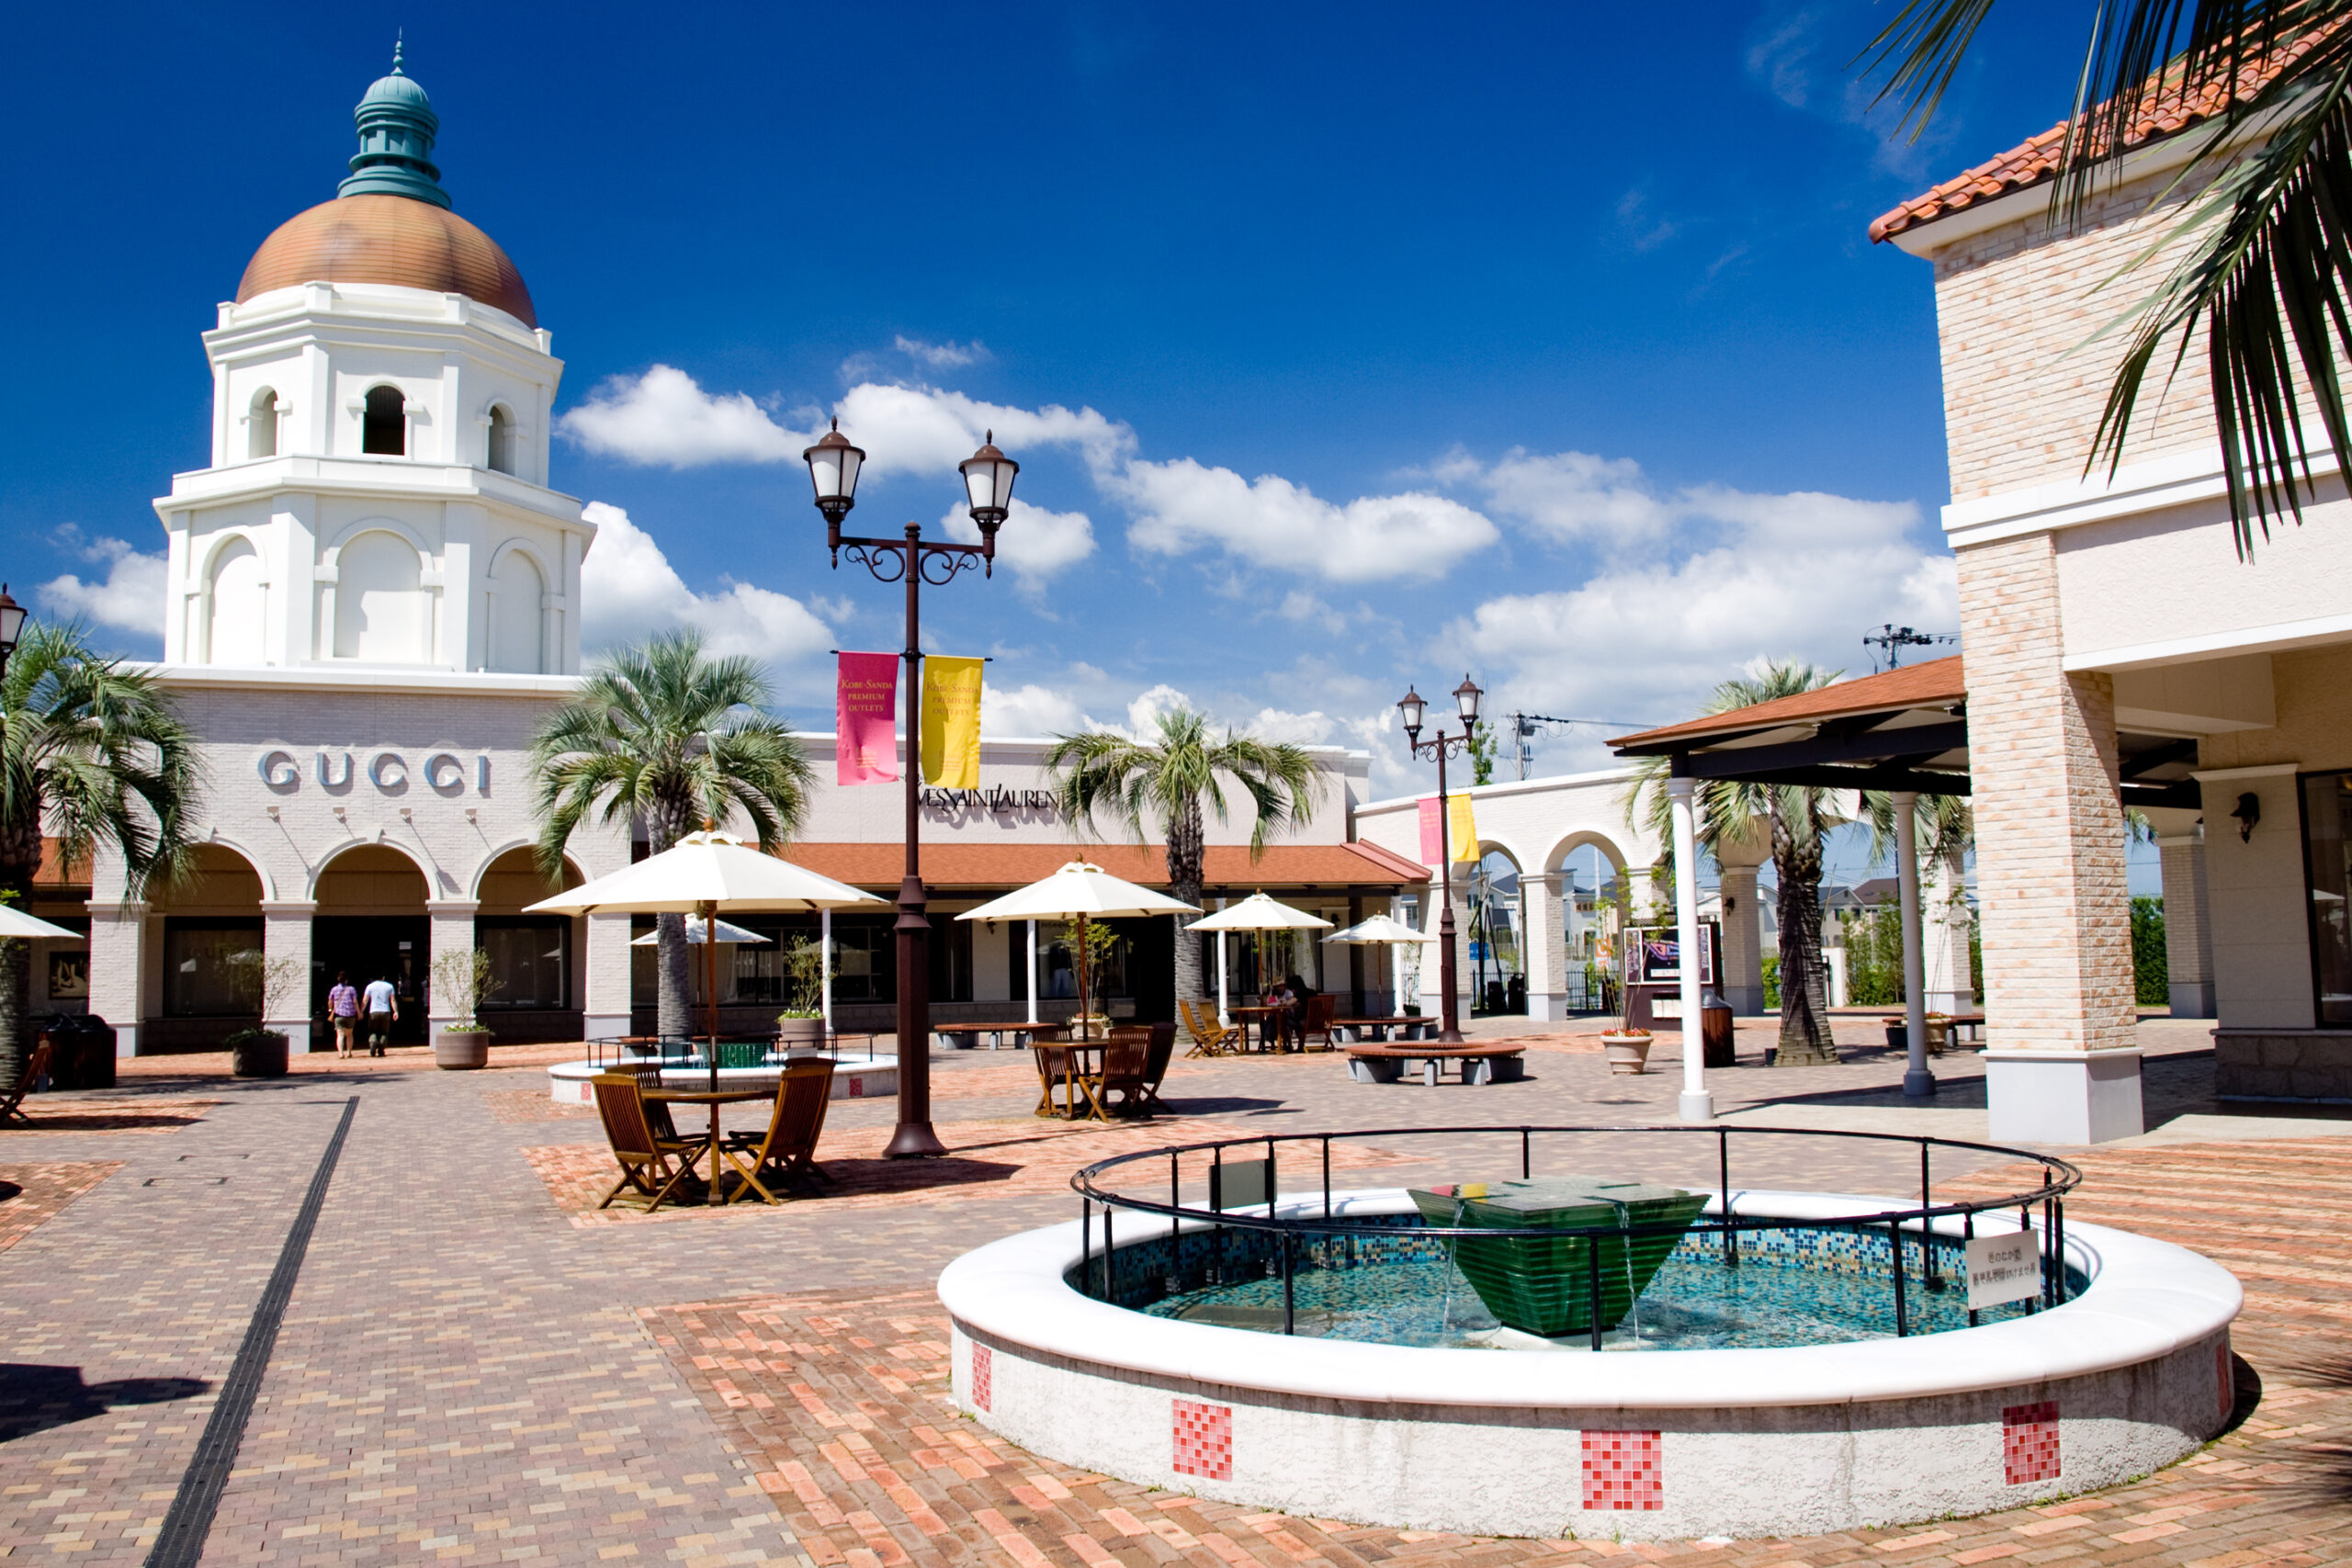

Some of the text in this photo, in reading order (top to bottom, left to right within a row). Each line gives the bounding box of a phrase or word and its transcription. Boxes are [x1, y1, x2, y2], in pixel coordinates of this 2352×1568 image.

[847, 693, 886, 701] PREMIUM
[933, 697, 972, 705] PREMIUM
[257, 750, 487, 789] GUCCI
[917, 787, 946, 807] VES
[993, 783, 1062, 813] LAUREN
